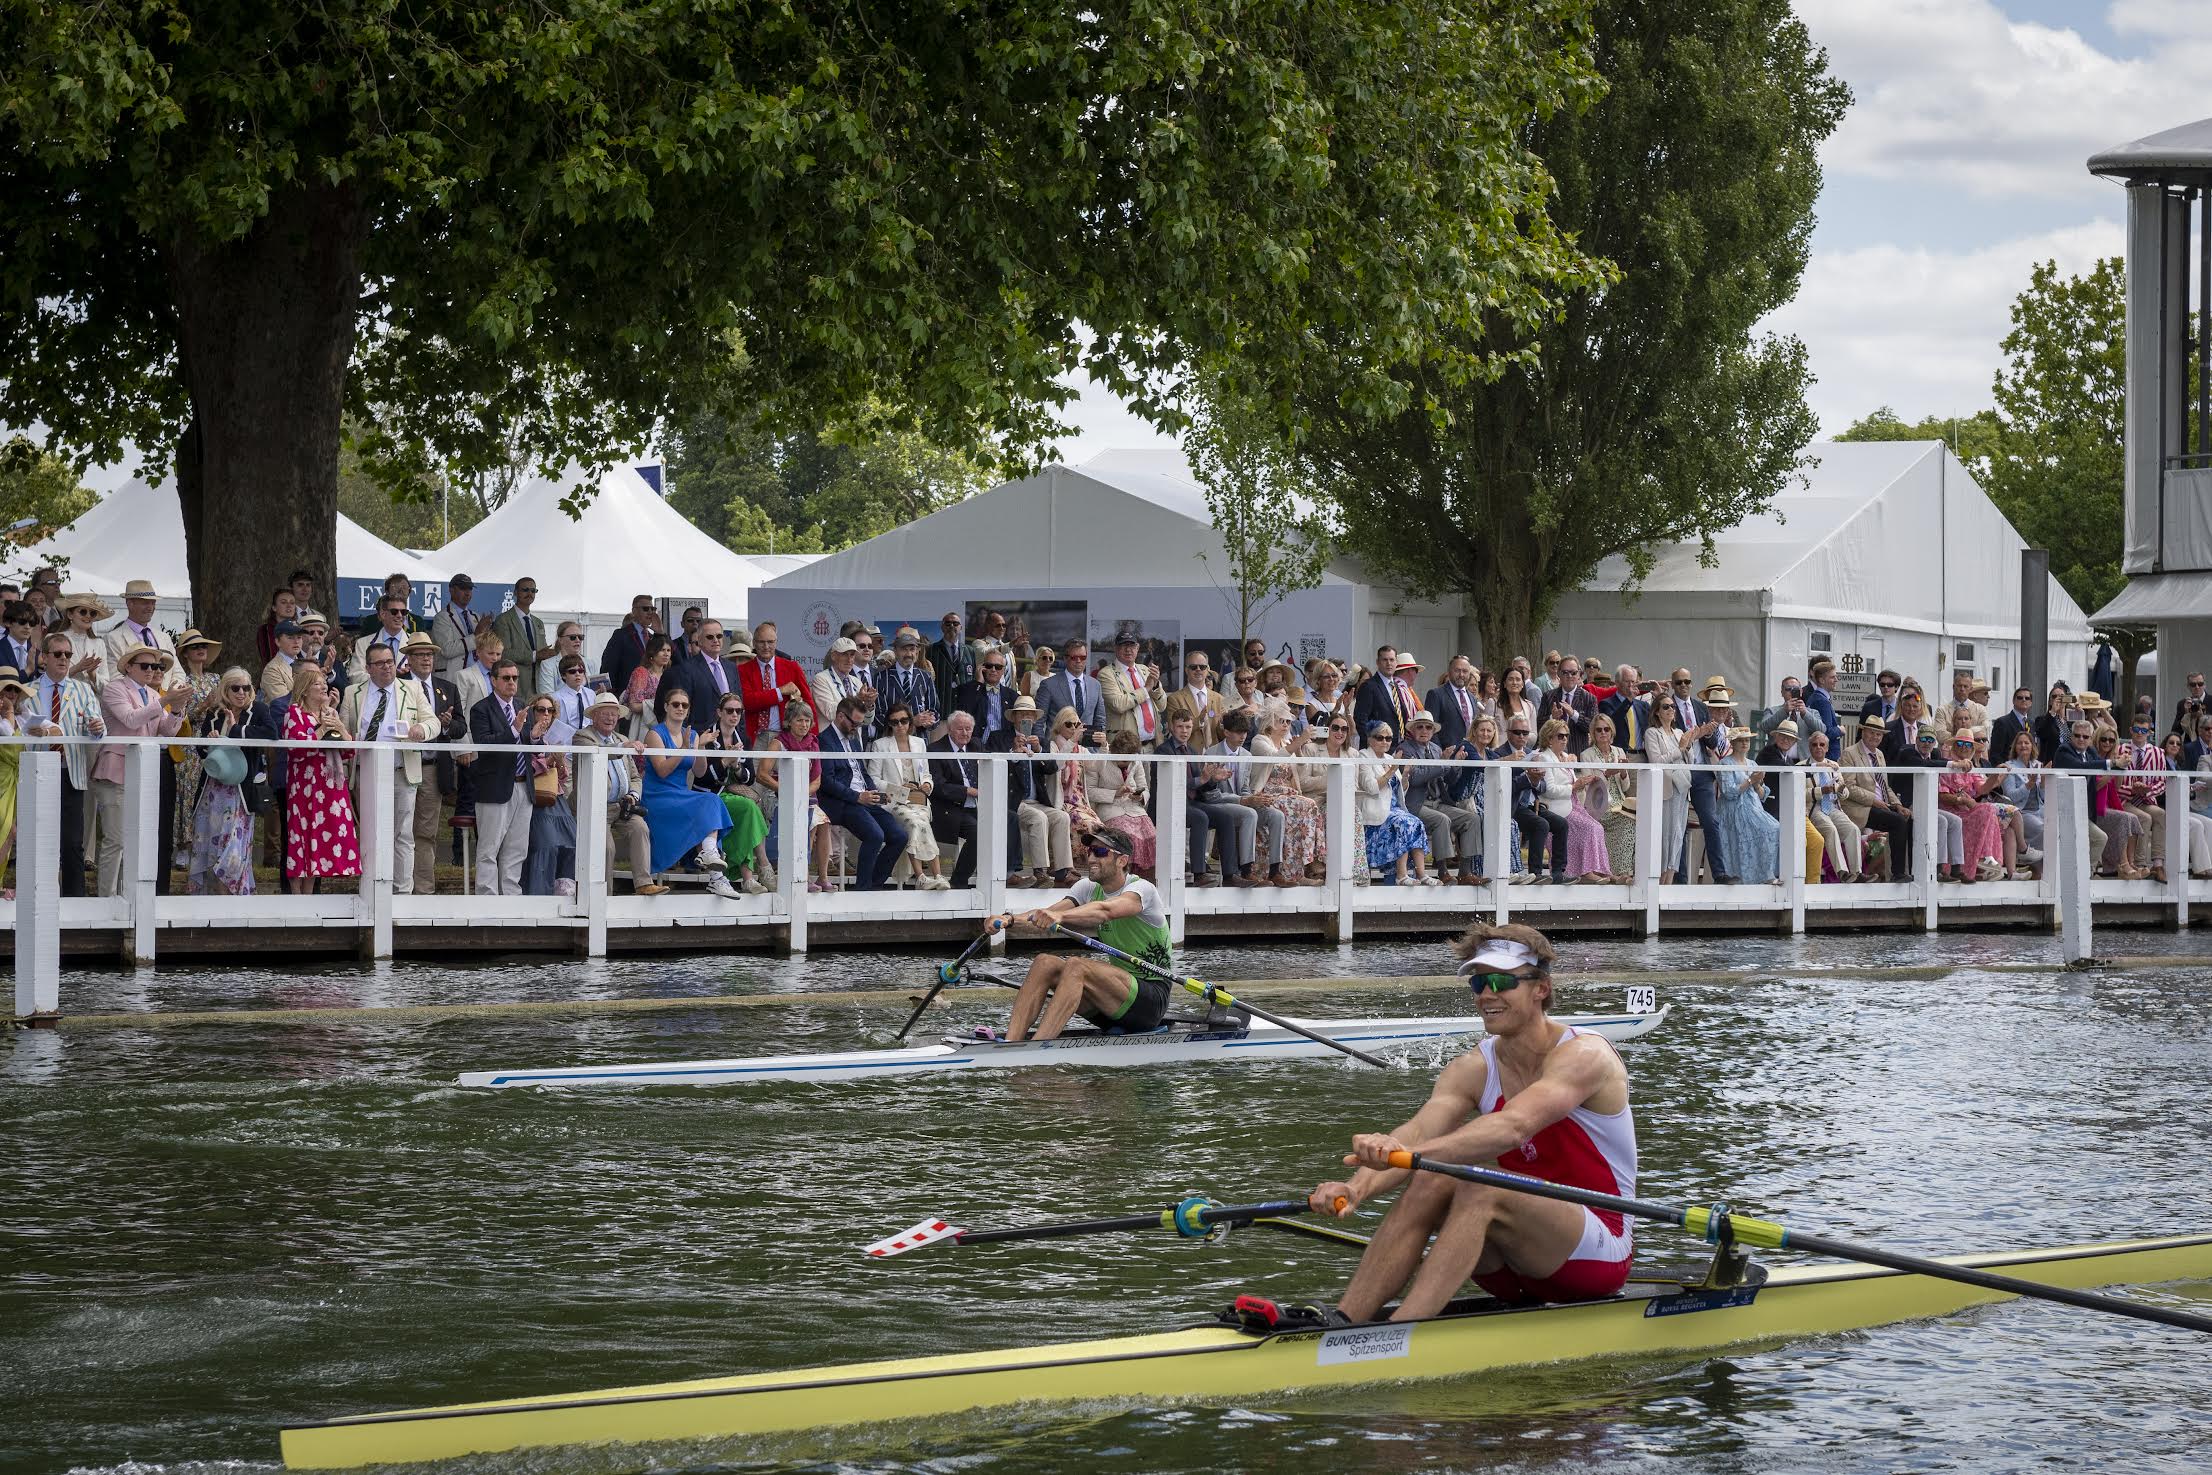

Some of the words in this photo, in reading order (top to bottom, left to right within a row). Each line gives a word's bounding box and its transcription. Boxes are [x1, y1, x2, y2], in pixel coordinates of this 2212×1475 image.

[808, 656, 825, 664] Trus
[1630, 989, 1653, 1007] 745
[1060, 1037, 1088, 1049] LDU
[1087, 1036, 1109, 1047] 999
[1113, 1035, 1141, 1046] Chris
[1143, 1034, 1182, 1045] Swartz
[1276, 1332, 1325, 1344] EMPACHER
[1326, 1328, 1407, 1348] BUNDESPOLIZEI
[1349, 1341, 1403, 1358] Spitzensport
